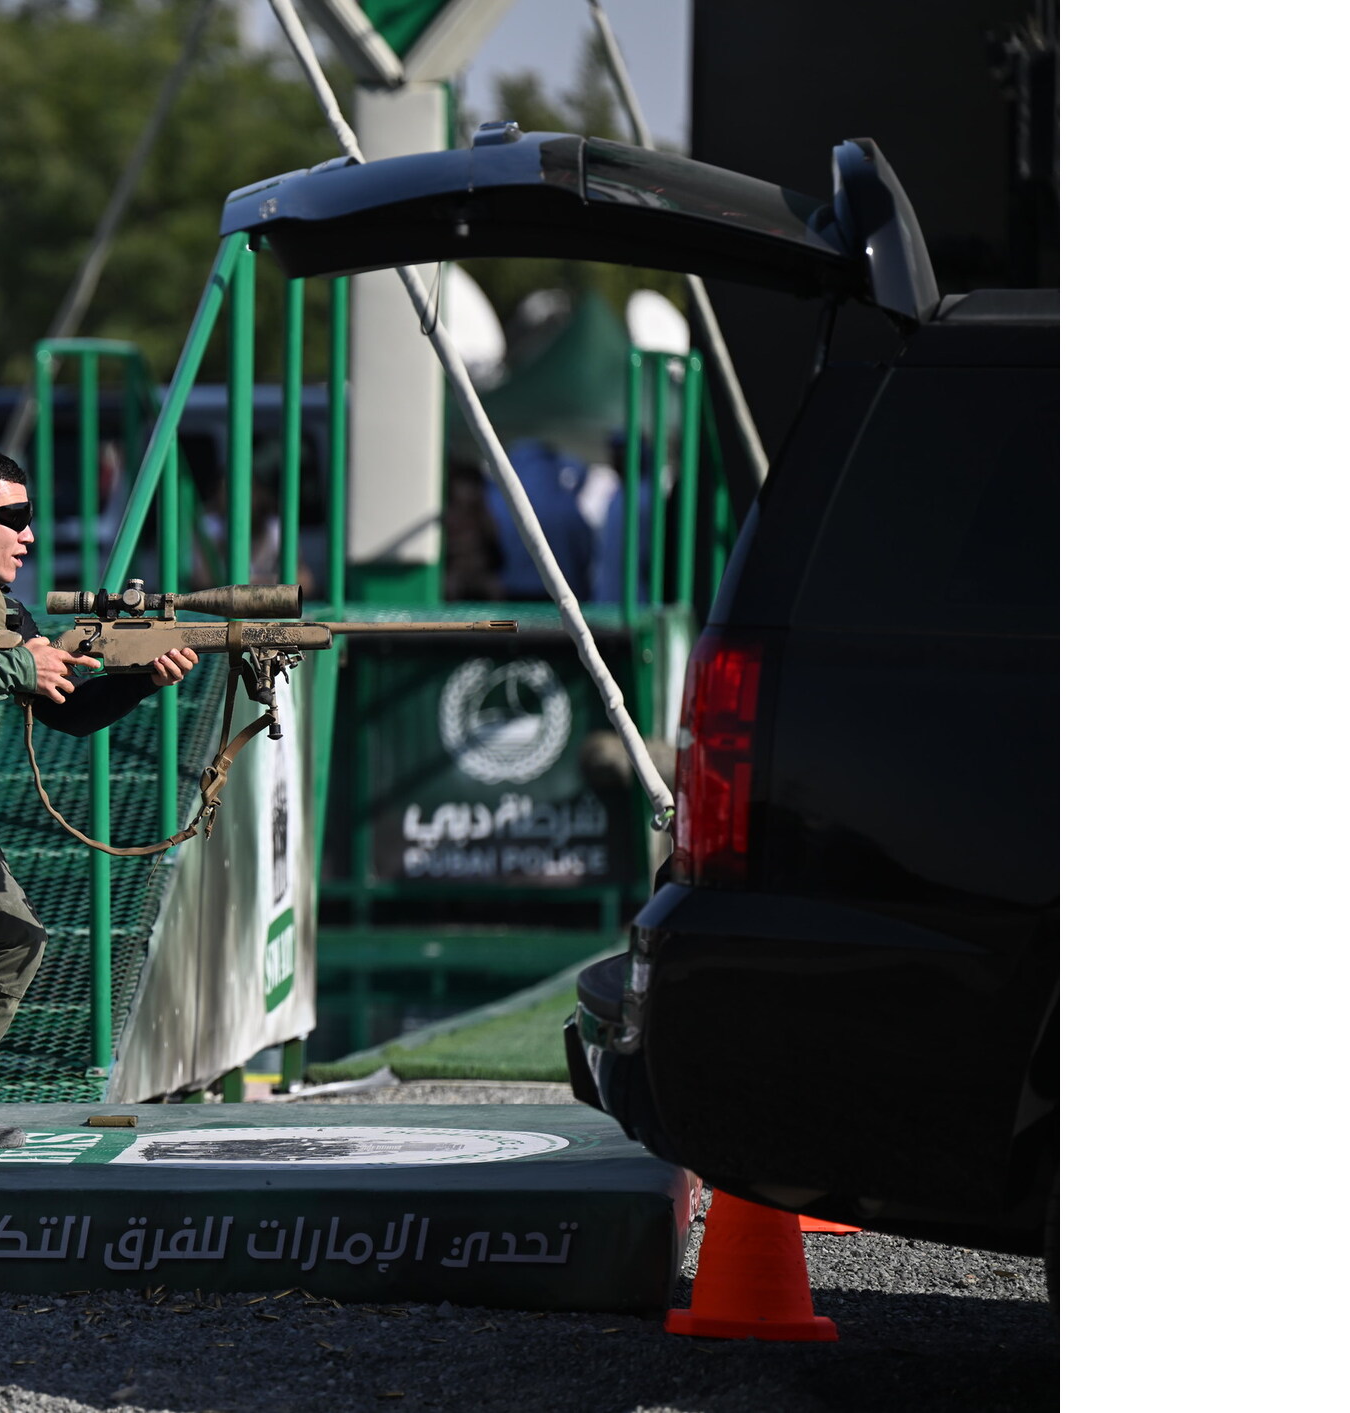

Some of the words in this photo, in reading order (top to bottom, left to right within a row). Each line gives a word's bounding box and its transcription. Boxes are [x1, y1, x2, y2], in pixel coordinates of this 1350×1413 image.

[103, 1215, 234, 1271] للفرق
[245, 1213, 430, 1273] الإمارات
[440, 1221, 579, 1268] تحدي
